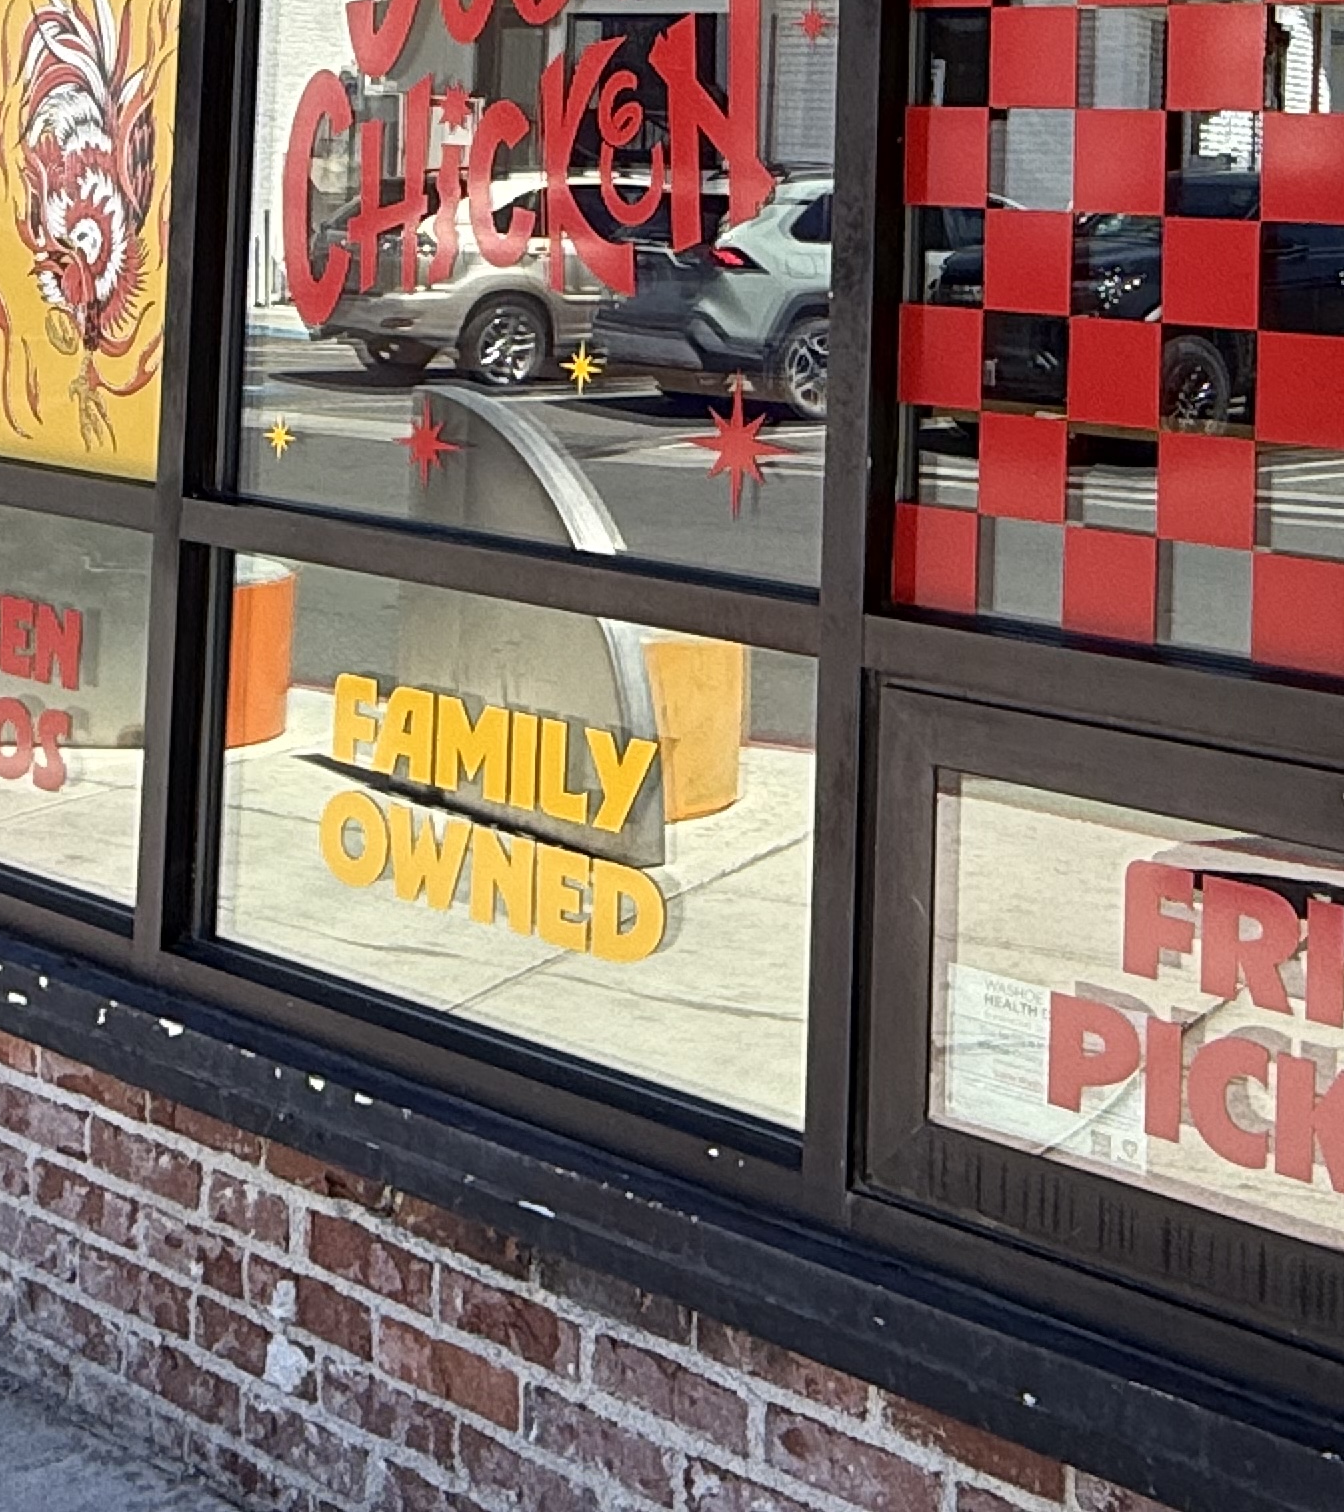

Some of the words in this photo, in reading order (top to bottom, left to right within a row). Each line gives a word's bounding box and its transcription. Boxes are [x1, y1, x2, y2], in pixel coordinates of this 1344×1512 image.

[331, 673, 658, 833] FAMILY
[319, 790, 667, 965] OWNED
[984, 992, 1038, 1019] HEALTH
[985, 978, 1045, 1006] WASHOE
